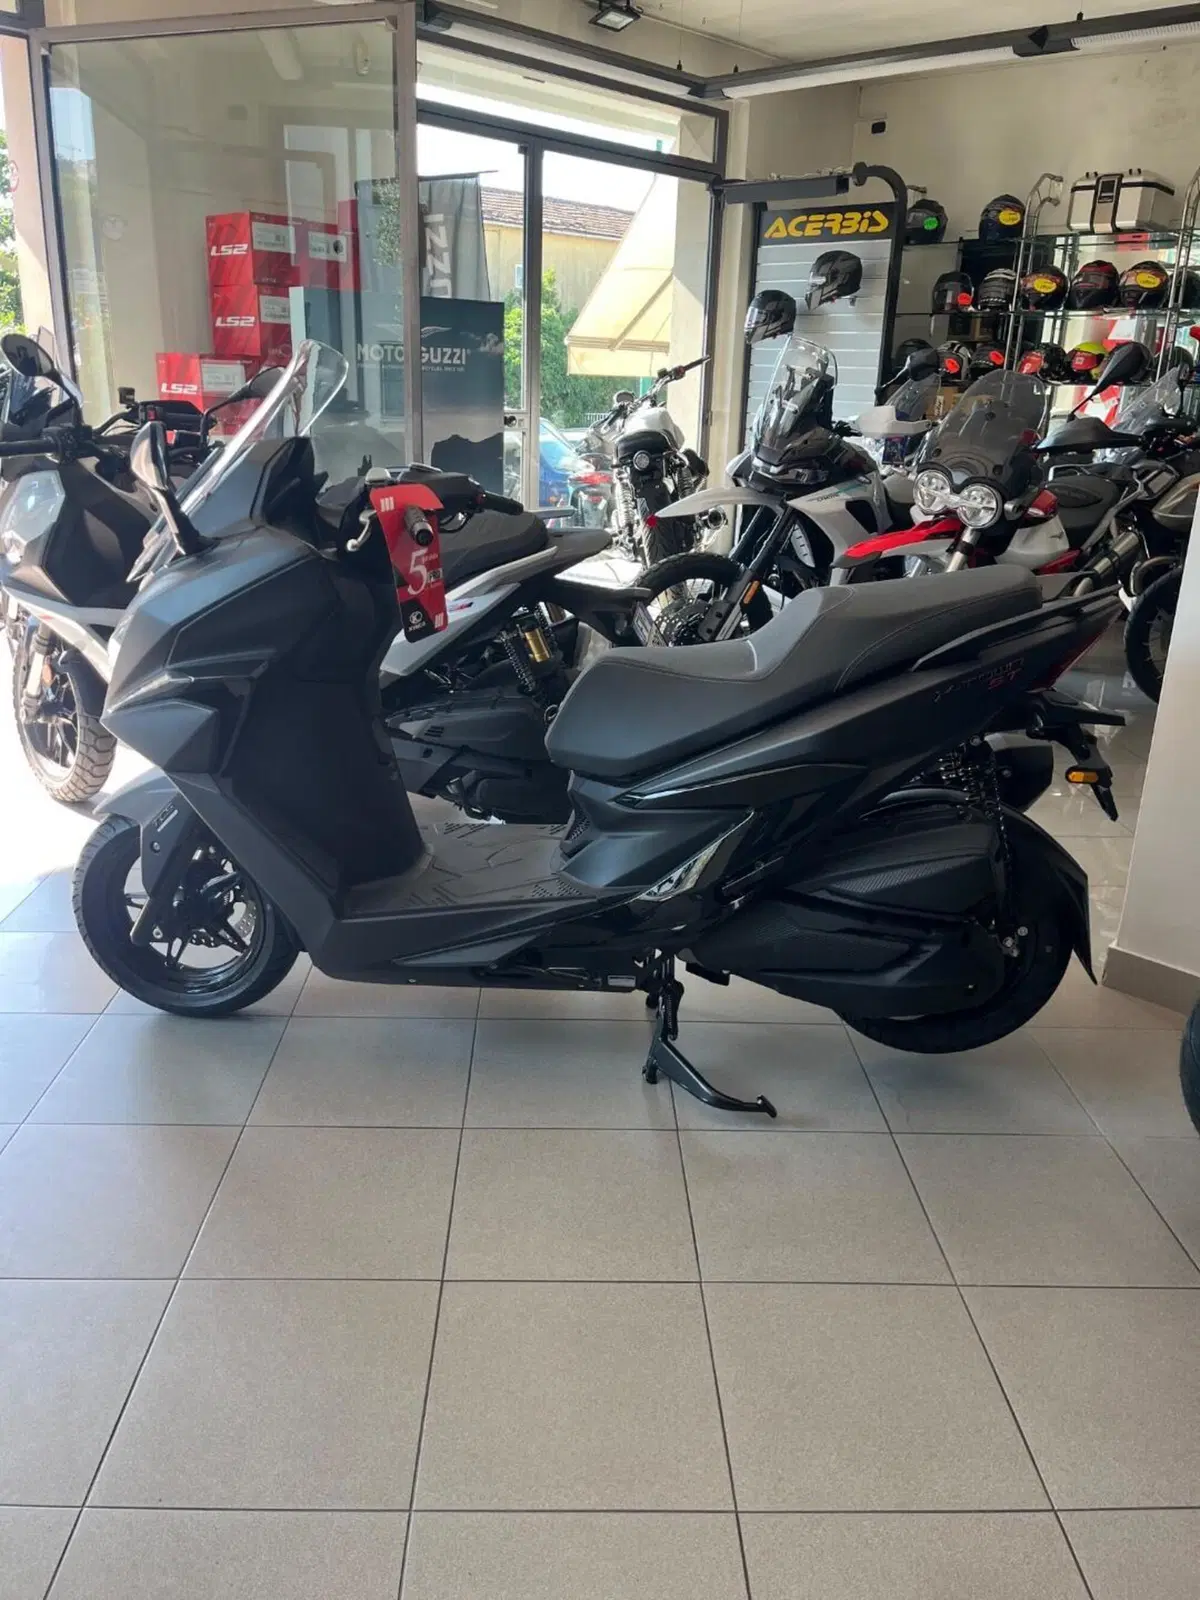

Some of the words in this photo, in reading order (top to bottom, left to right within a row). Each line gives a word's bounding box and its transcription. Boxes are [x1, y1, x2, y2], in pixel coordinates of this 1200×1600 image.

[210, 243, 249, 257] LS2
[215, 315, 255, 327] LS2
[357, 343, 404, 362] MOTO
[161, 382, 198, 395] LS2
[407, 548, 429, 595] 5
